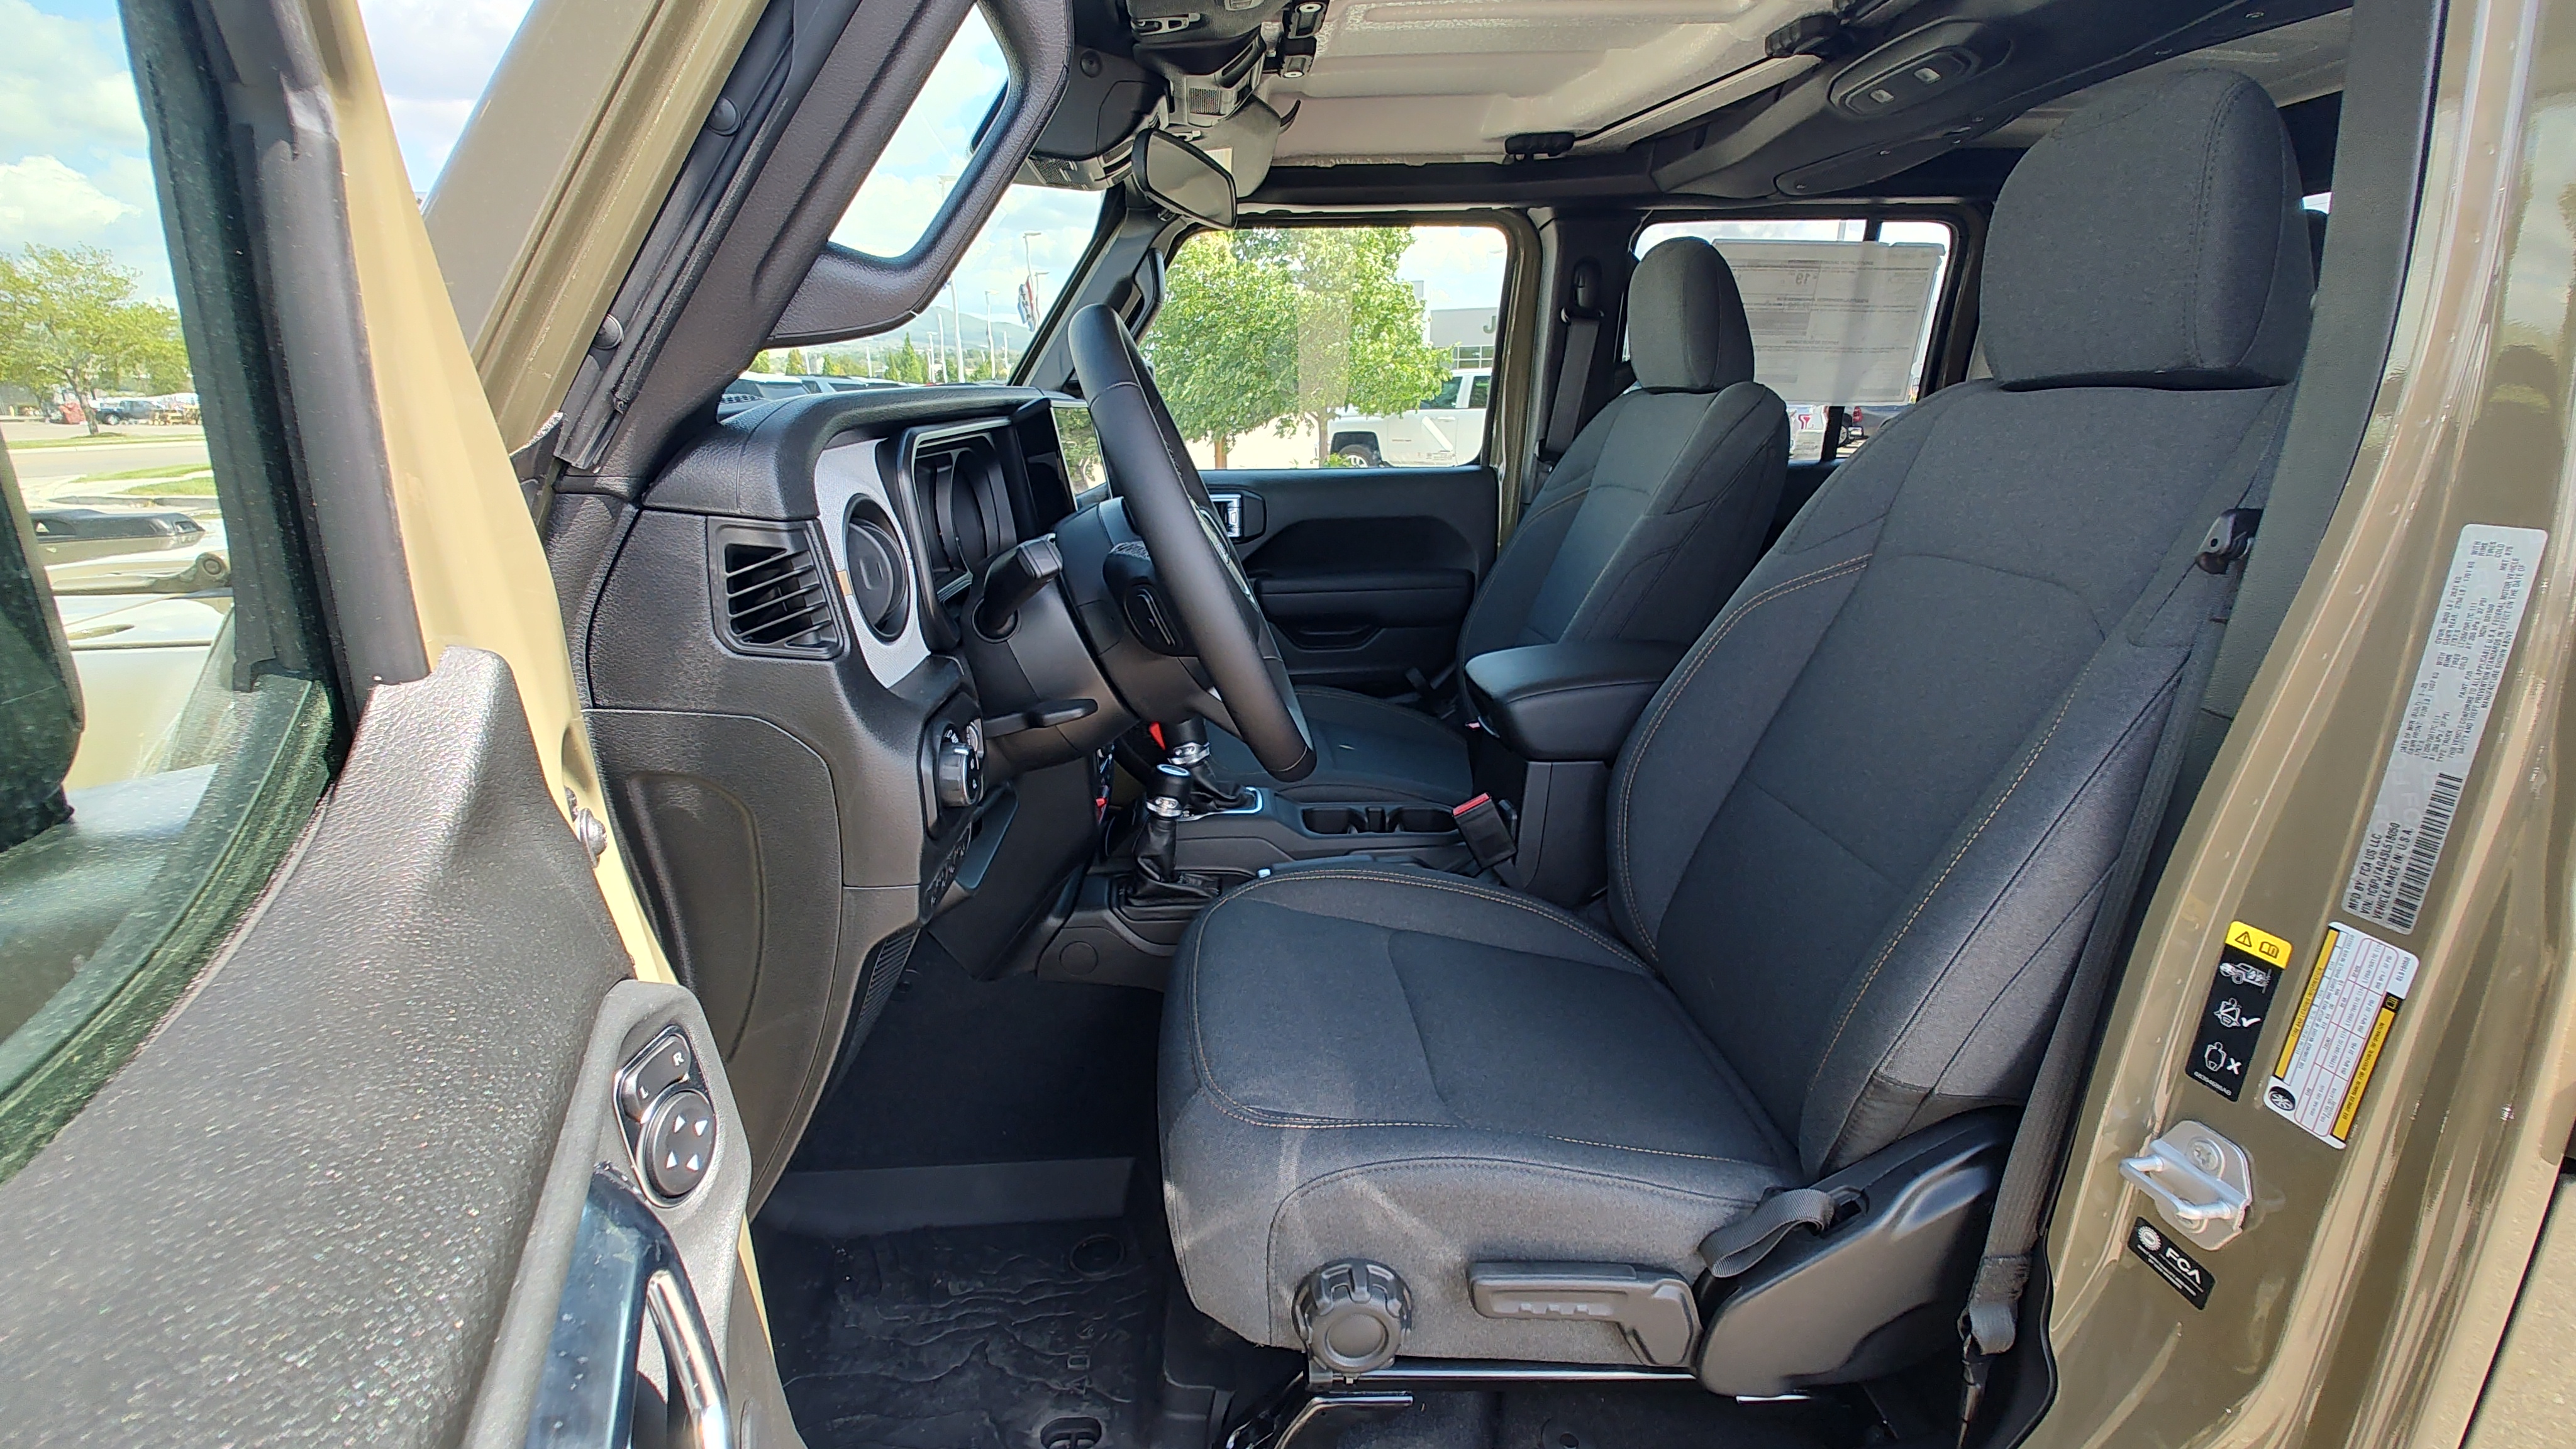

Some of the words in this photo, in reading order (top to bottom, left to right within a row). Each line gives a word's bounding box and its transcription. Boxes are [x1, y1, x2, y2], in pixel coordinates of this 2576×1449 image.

[2368, 832, 2382, 848] LLC
[2364, 848, 2377, 860] US
[2358, 860, 2372, 877] FCA
[2372, 887, 2392, 920] VEHICLE
[2383, 863, 2400, 888] MADE
[673, 1052, 685, 1067] R
[2165, 1247, 2201, 1284] FCA
